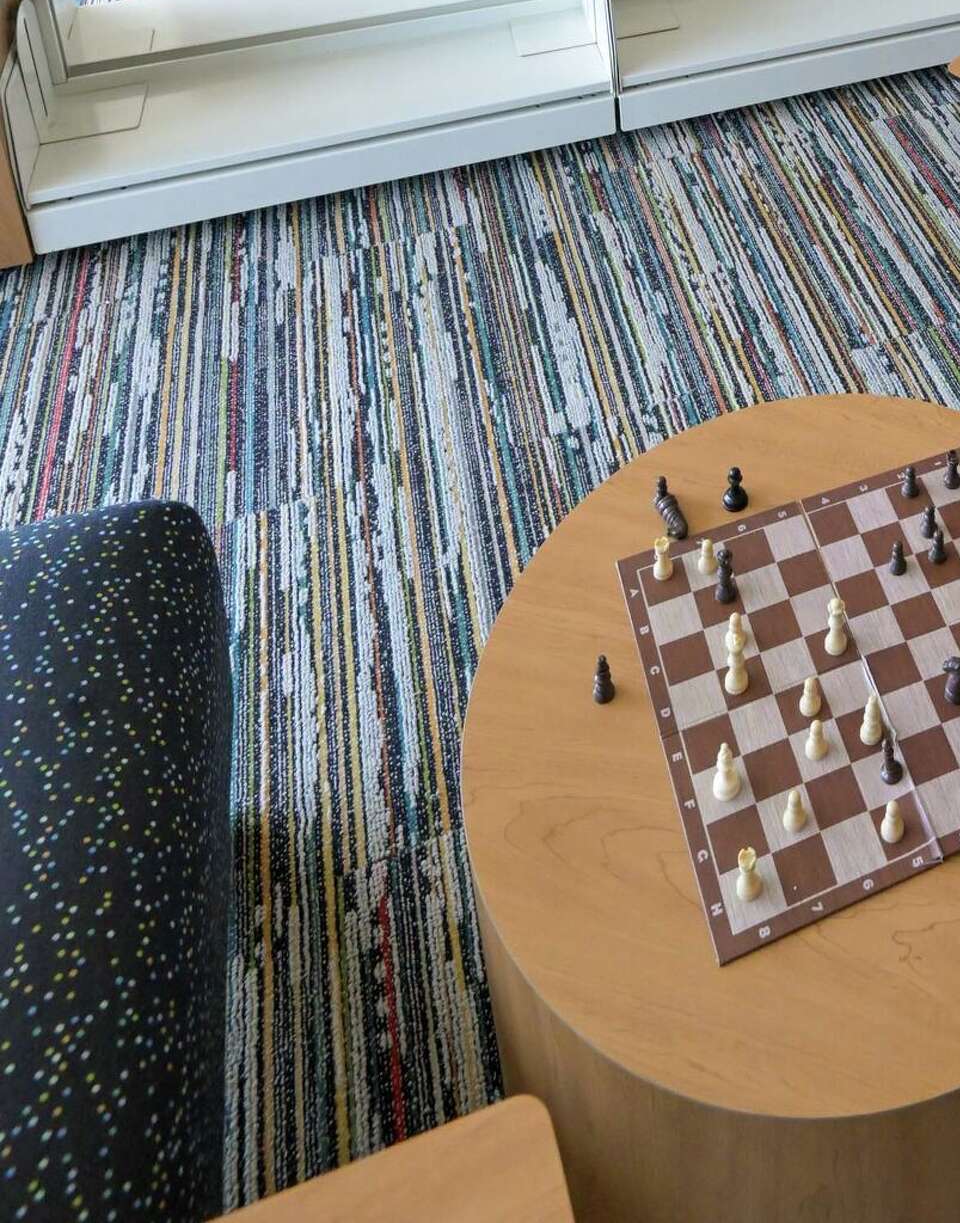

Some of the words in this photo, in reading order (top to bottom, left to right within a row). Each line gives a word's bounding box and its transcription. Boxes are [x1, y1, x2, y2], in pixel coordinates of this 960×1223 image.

[630, 589, 639, 597] A
[639, 624, 649, 634] B
[650, 665, 660, 676] C
[660, 707, 671, 718] D
[672, 751, 683, 762] E
[684, 798, 696, 809] F
[697, 849, 709, 863] G
[710, 901, 724, 916] H
[811, 902, 823, 913] 7
[862, 878, 874, 890] 6
[912, 857, 924, 868] 5
